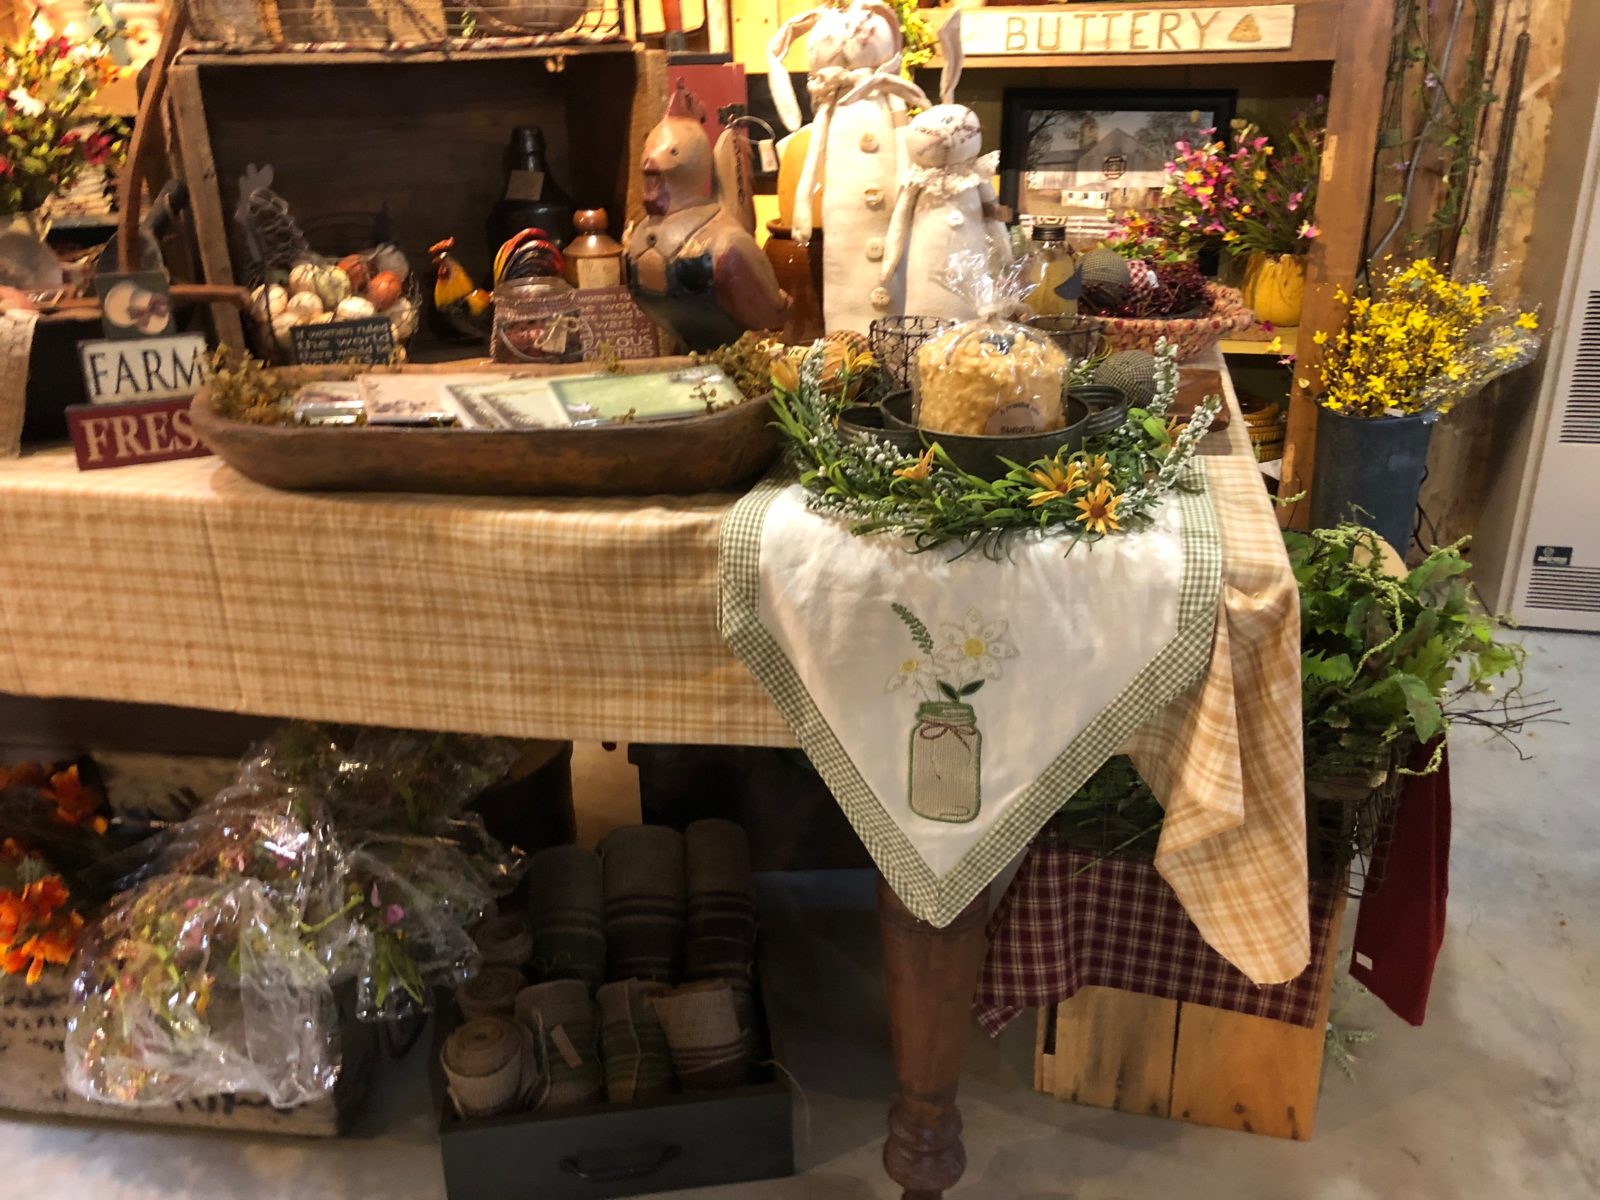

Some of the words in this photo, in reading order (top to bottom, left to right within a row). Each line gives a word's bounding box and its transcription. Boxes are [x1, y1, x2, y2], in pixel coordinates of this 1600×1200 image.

[1005, 11, 1221, 51] BUTTERY
[89, 347, 206, 395] FARM
[80, 409, 199, 463] FRES
